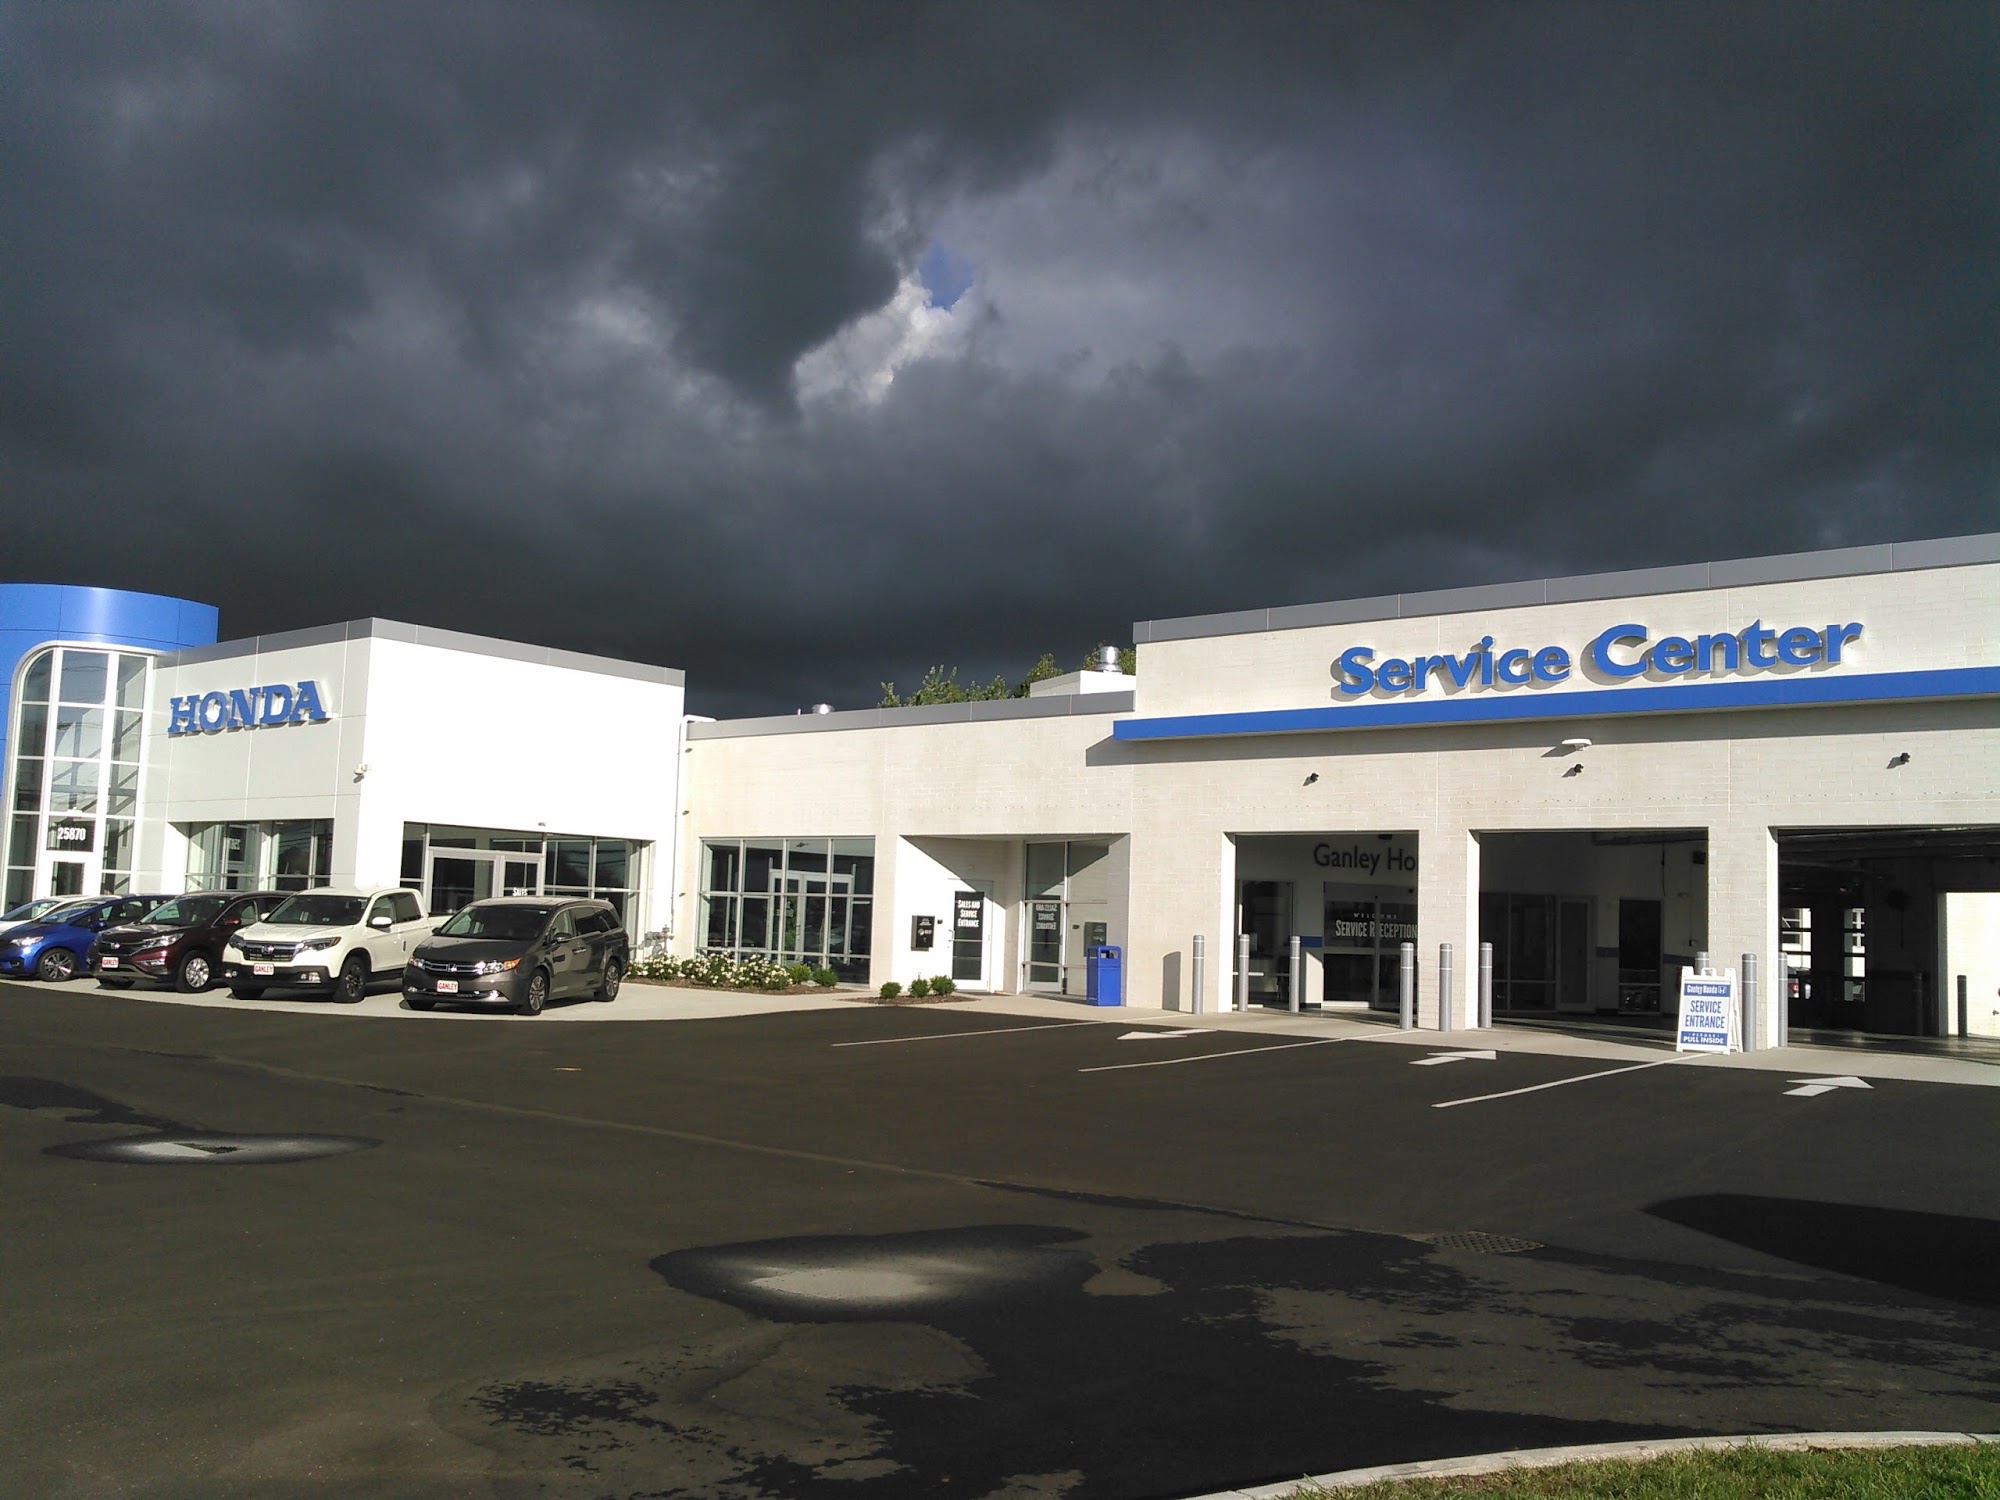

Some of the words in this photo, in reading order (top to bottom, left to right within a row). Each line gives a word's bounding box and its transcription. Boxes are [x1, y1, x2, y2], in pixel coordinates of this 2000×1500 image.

[1339, 635, 1571, 695] Service
[1592, 618, 1864, 679] Center
[167, 680, 327, 734] HONDA
[57, 827, 87, 841] 25870
[1314, 843, 1380, 876] Ganley
[1387, 847, 1417, 872] Ho
[958, 900, 971, 909] SALES
[972, 901, 981, 909] AND
[960, 909, 978, 918] SERVICE
[958, 919, 979, 928] ENTRANCE
[1335, 919, 1368, 937] SERVICE
[1369, 921, 1418, 939] RECEPTION
[1686, 985, 1702, 994] Ganley
[1703, 986, 1718, 994] Honda
[1690, 1000, 1722, 1013] SERVICE
[1685, 1015, 1725, 1028] ENTRANCE
